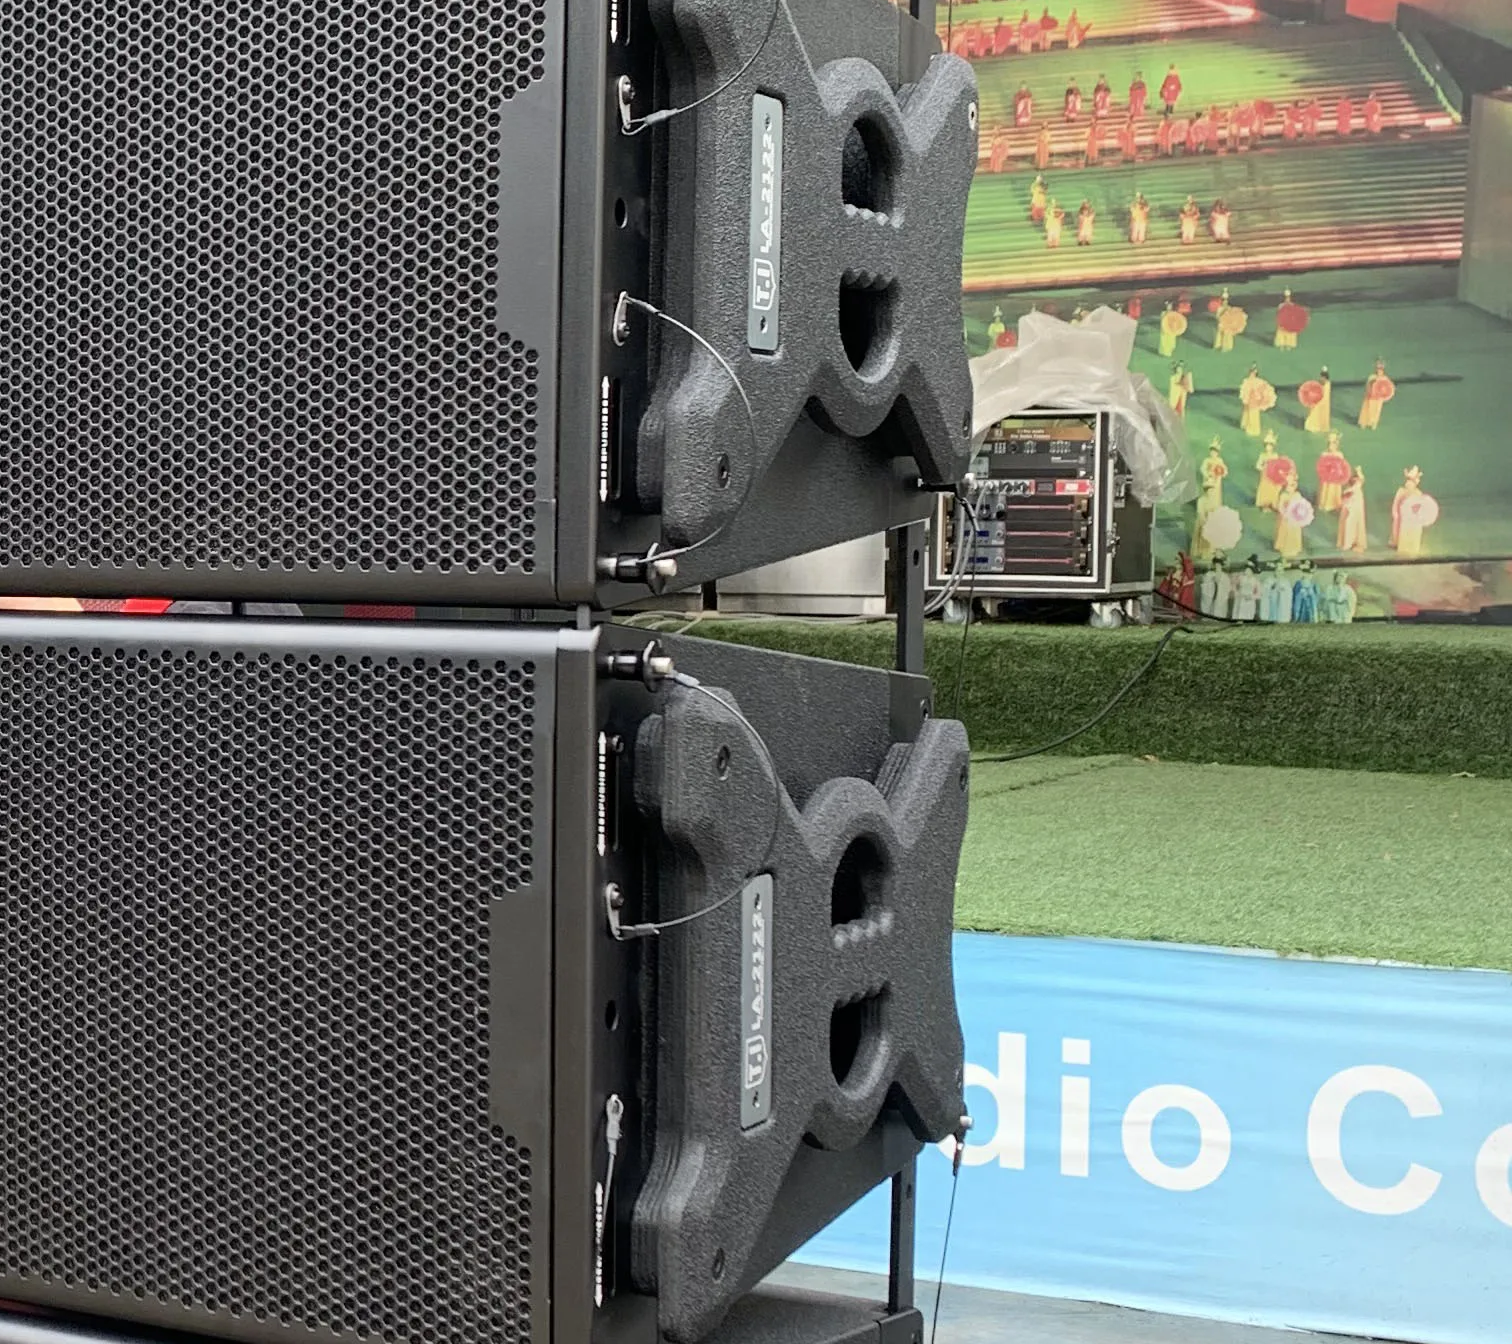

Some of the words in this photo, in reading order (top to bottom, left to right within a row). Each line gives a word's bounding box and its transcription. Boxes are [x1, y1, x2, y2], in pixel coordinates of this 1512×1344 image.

[760, 133, 773, 253] LA-2122
[756, 261, 771, 303] T.I
[751, 912, 764, 1031] LA-2122
[748, 1043, 762, 1082] T.I
